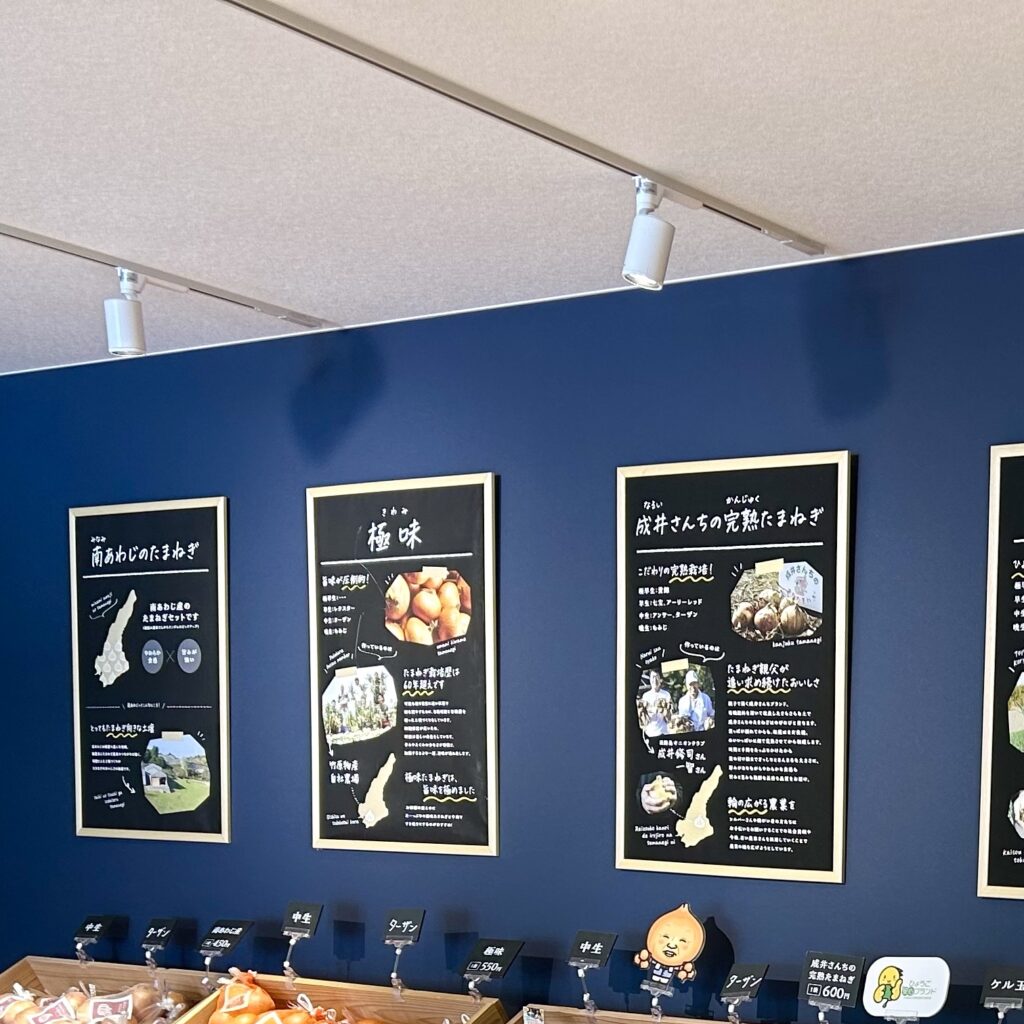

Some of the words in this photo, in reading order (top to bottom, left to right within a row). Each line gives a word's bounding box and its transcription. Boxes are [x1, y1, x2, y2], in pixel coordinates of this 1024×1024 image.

[643, 500, 663, 510] なるい
[725, 494, 760, 505] かんじゅく
[381, 506, 409, 517] きわみ
[635, 506, 825, 536] 成井さんちの完熟たまねぎ
[367, 518, 423, 552] 極味
[91, 541, 200, 568] 南あわじのたまねぎ
[638, 562, 713, 578] こだわりの完熟栽培!
[142, 613, 200, 623] たまねぎセットです
[727, 662, 790, 675] たまねぎ親父が
[726, 676, 820, 689] 追い求め続けたおいしさ
[291, 910, 312, 925] 中生
[389, 918, 419, 933] ターザン
[579, 941, 604, 955] 中生
[810, 957, 857, 973] 成井さんちの
[808, 970, 856, 985] 完熟たまねぎ
[821, 985, 851, 1001] 600円
